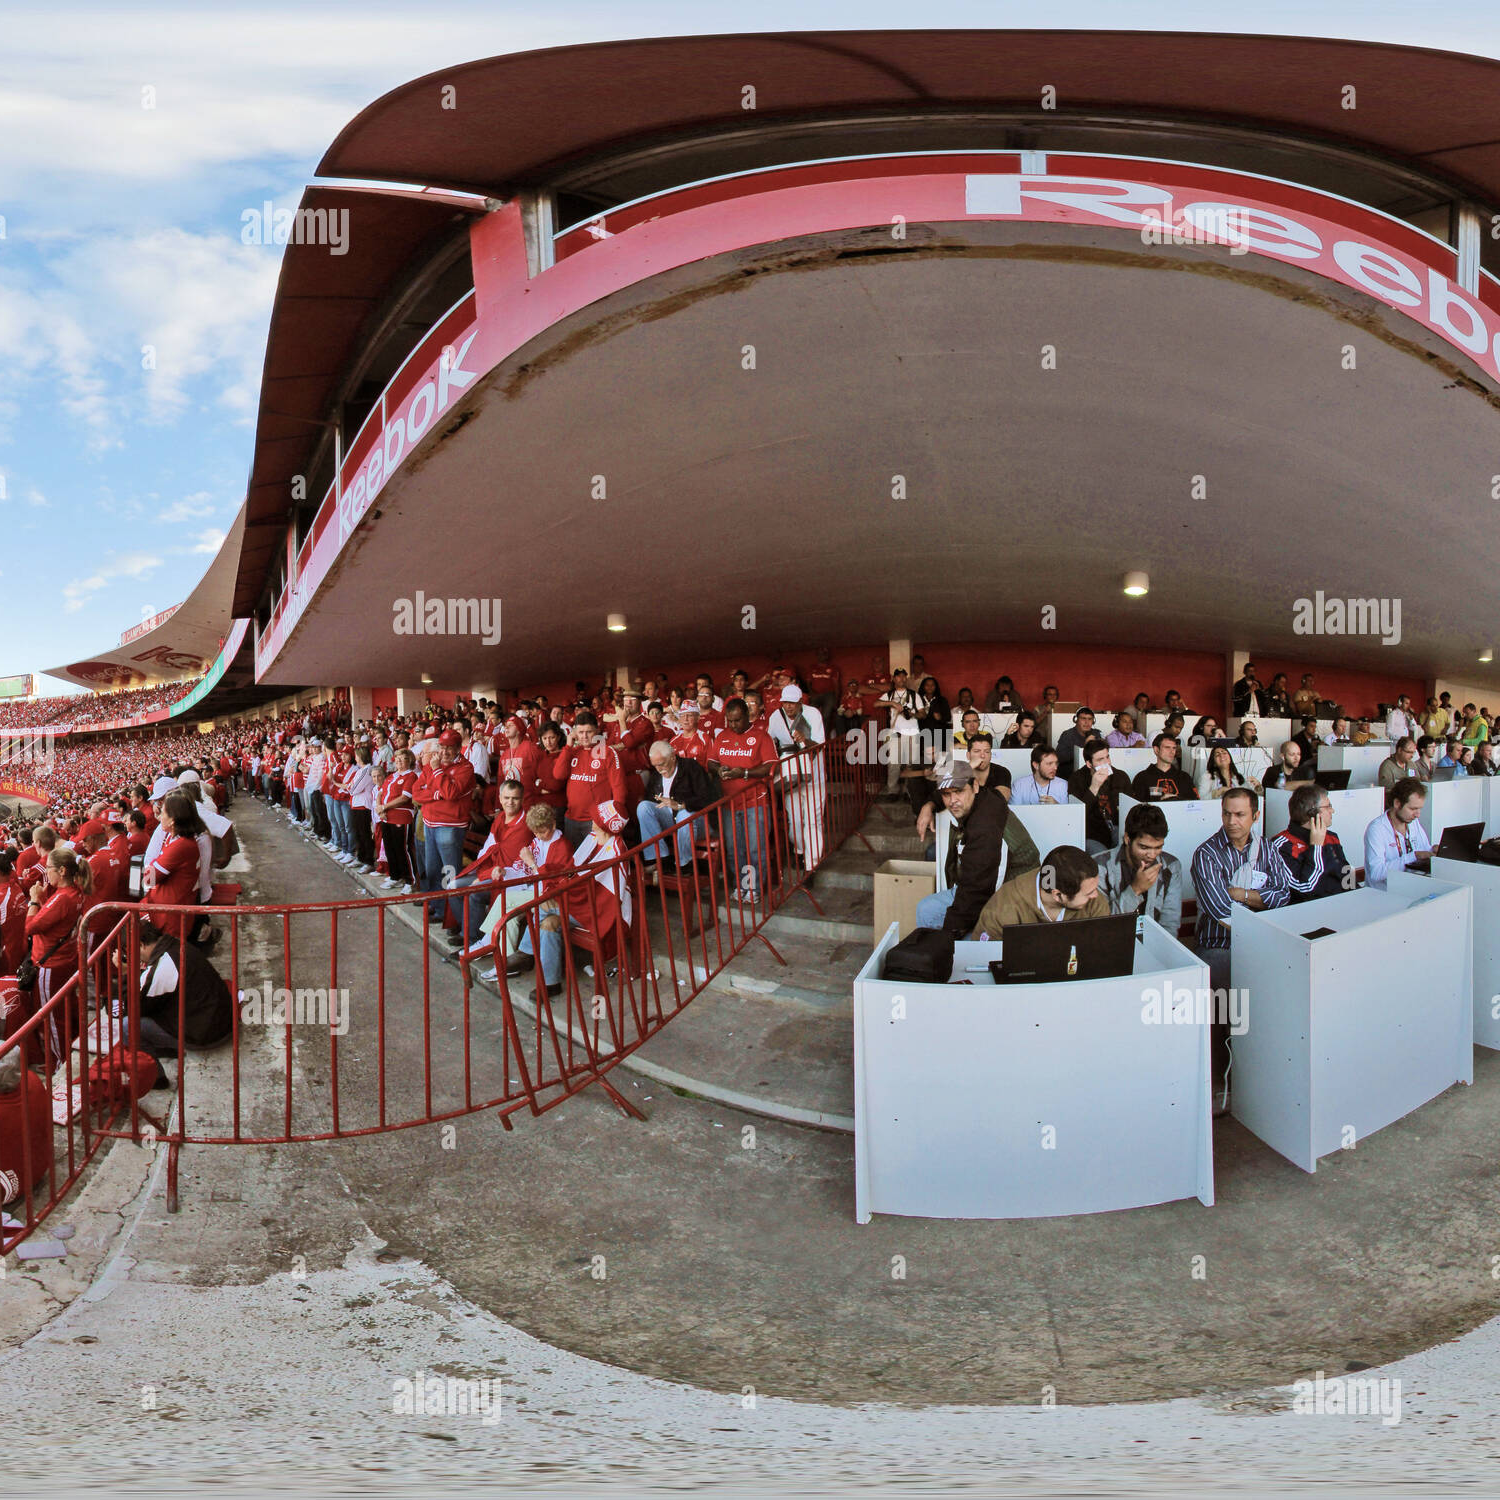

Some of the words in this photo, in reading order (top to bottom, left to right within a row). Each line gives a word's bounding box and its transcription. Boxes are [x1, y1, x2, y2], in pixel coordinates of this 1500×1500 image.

[966, 174, 1500, 386] Reeb
[338, 329, 479, 546] Reebok
[570, 772, 597, 782] anrisul
[719, 747, 753, 757] Banrisul
